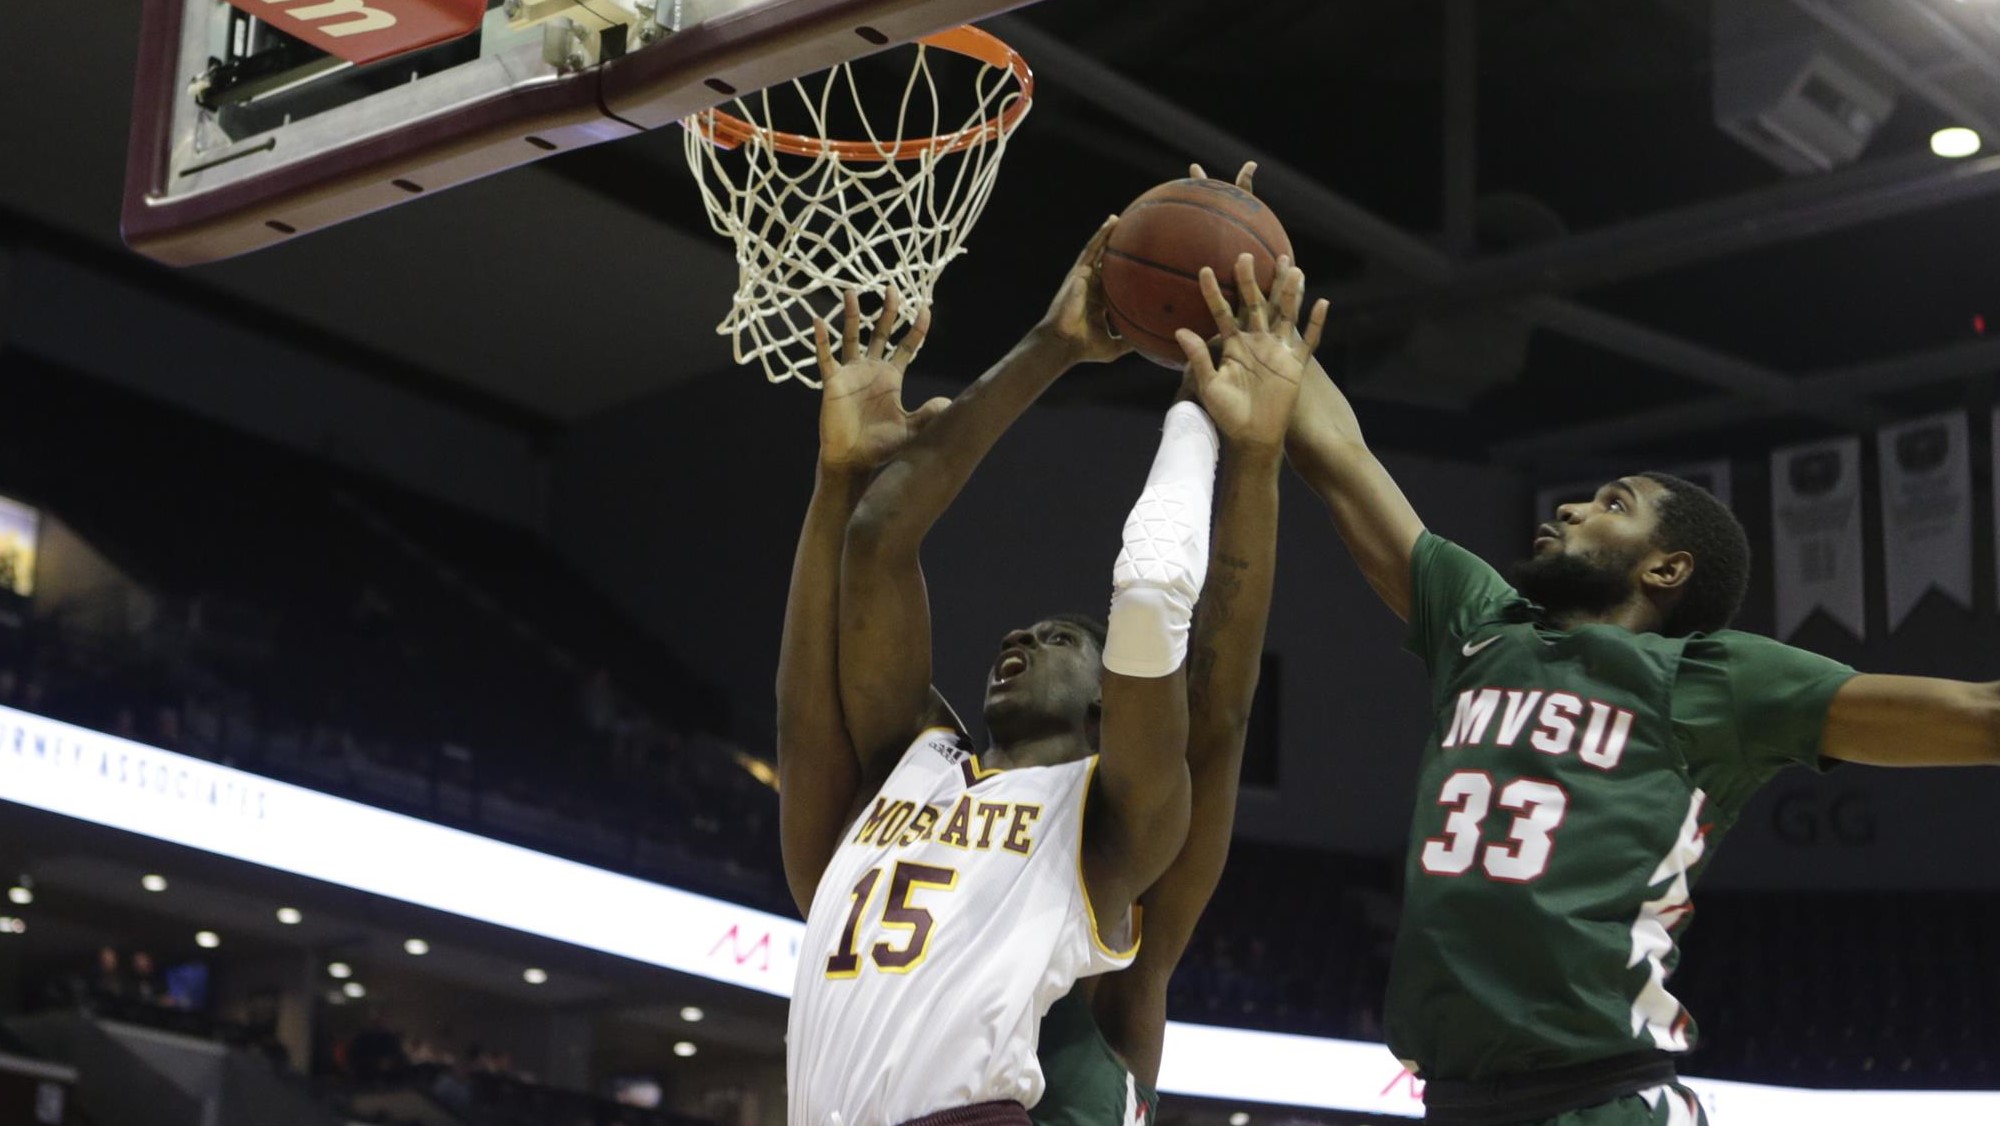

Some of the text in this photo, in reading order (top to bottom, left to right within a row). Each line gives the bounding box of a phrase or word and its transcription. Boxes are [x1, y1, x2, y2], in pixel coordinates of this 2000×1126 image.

[1441, 686, 1635, 771] MVSU
[97, 750, 267, 820] ASSOCIATES
[1420, 769, 1571, 884] 33
[825, 860, 959, 980] 15
